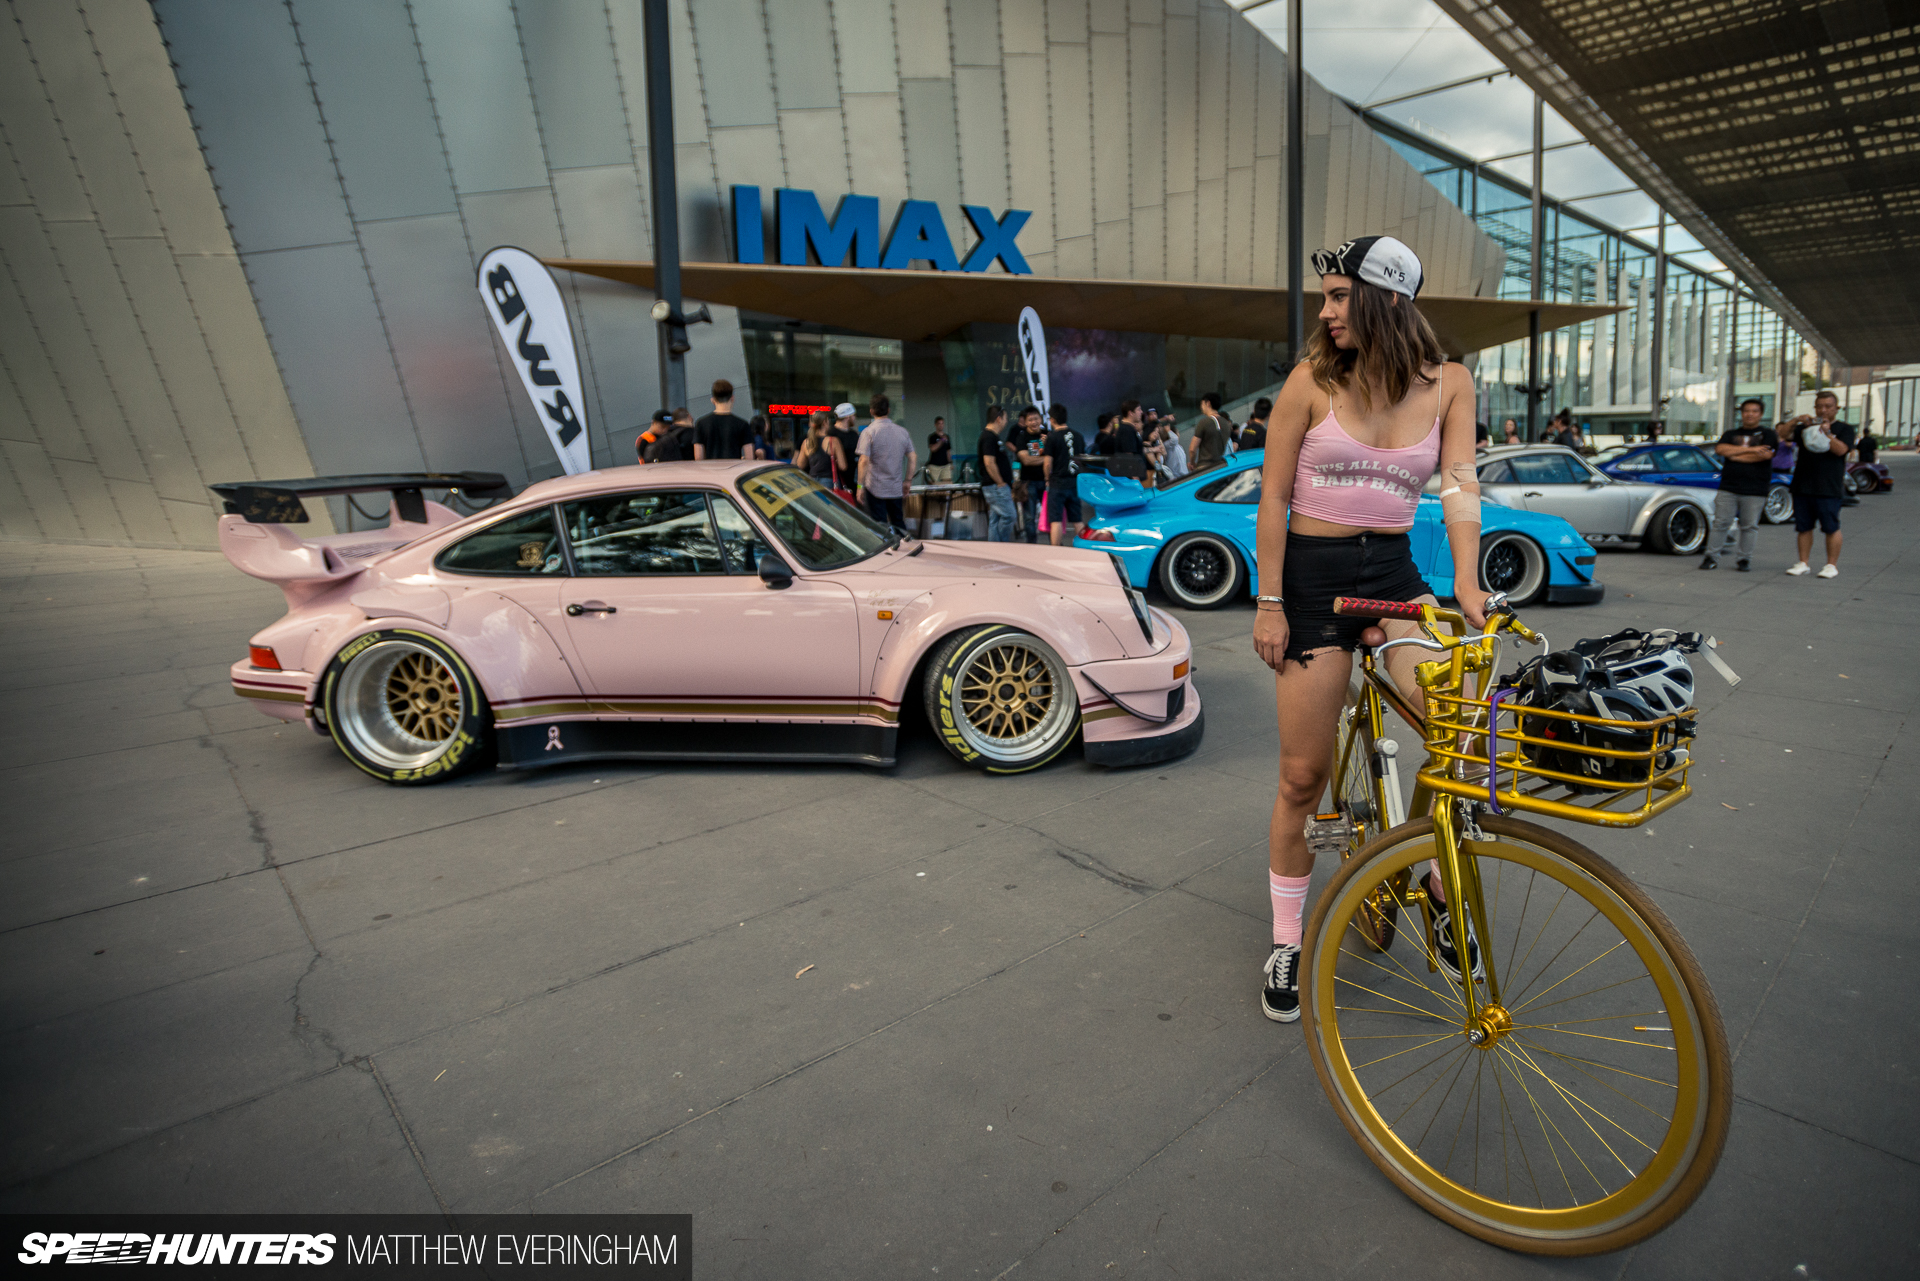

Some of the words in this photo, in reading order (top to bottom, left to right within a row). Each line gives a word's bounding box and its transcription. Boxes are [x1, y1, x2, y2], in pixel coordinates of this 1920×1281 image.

[730, 184, 1033, 275] IMAX
[986, 385, 1034, 405] SPAC
[1314, 461, 1344, 473] IT'S
[1348, 460, 1382, 471] ALL
[1311, 475, 1369, 488] BABY
[1370, 476, 1417, 504] BABY
[1569, 708, 1580, 734] LAZR
